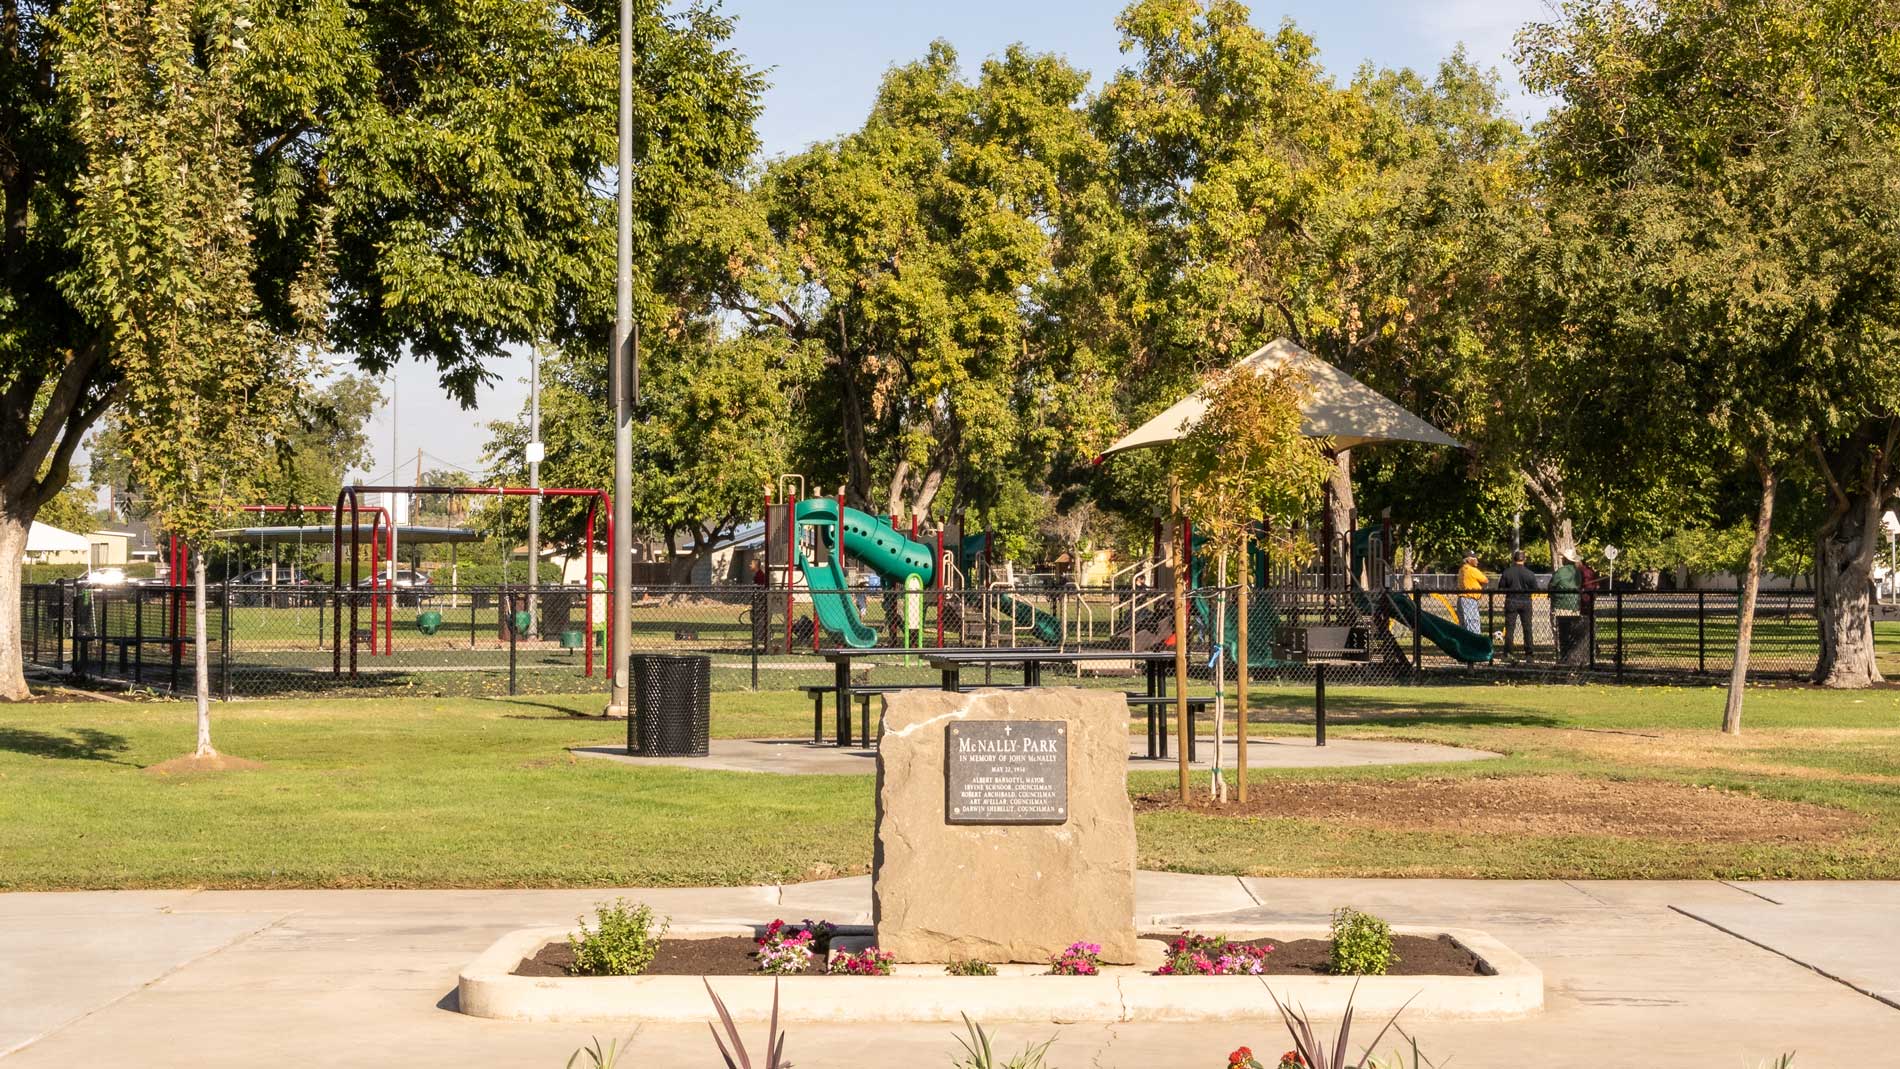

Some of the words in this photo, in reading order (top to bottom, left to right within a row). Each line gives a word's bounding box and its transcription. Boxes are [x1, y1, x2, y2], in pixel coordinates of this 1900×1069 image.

[959, 738, 1017, 752] McNALLY
[1023, 738, 1057, 752] PARK
[1009, 755, 1026, 763] JOHN
